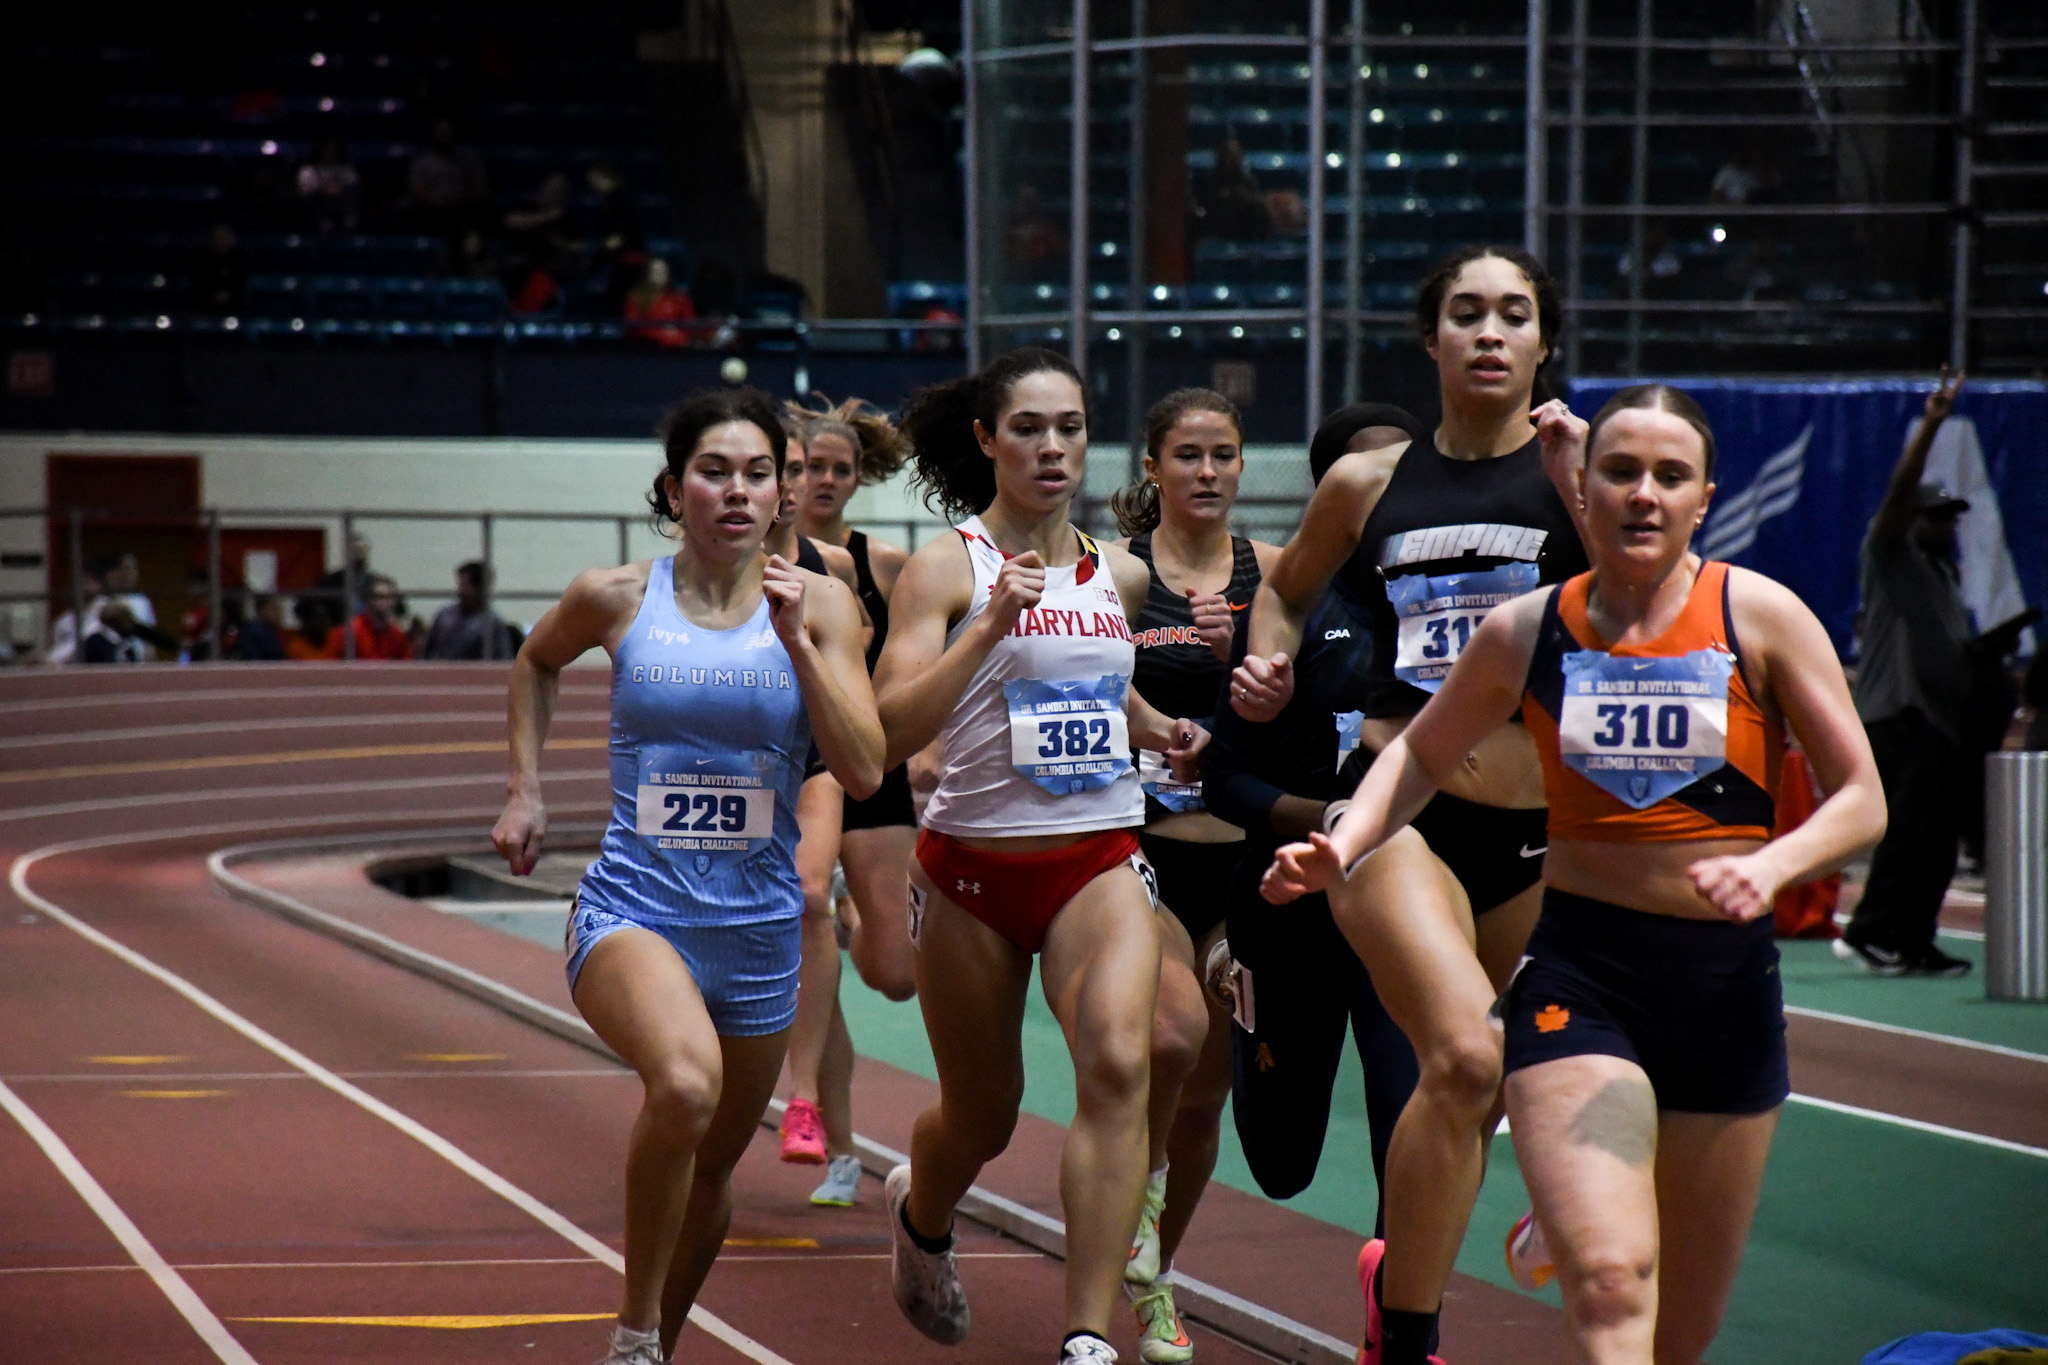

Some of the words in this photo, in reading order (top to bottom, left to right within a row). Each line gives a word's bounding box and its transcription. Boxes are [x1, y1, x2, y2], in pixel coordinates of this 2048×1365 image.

[1396, 523, 1549, 564] EMPIRE
[647, 625, 676, 646] Ivy
[1132, 625, 1213, 649] PRINC
[1324, 628, 1351, 641] CAA
[1423, 616, 1486, 659] 31
[632, 664, 792, 690] COLUMBIA
[1036, 701, 1069, 713] SANDER
[1038, 718, 1111, 758] 382
[1593, 704, 1689, 749] 310
[650, 773, 663, 784] DR.
[665, 774, 699, 785] SANDER
[701, 776, 763, 787] INVITATIONAL
[1035, 764, 1074, 776] COLUMBIA
[1075, 761, 1114, 775] CHALLENGE
[662, 793, 747, 832] 229
[658, 838, 700, 850] COLUMBIA
[702, 839, 749, 851] CHALLENGE
